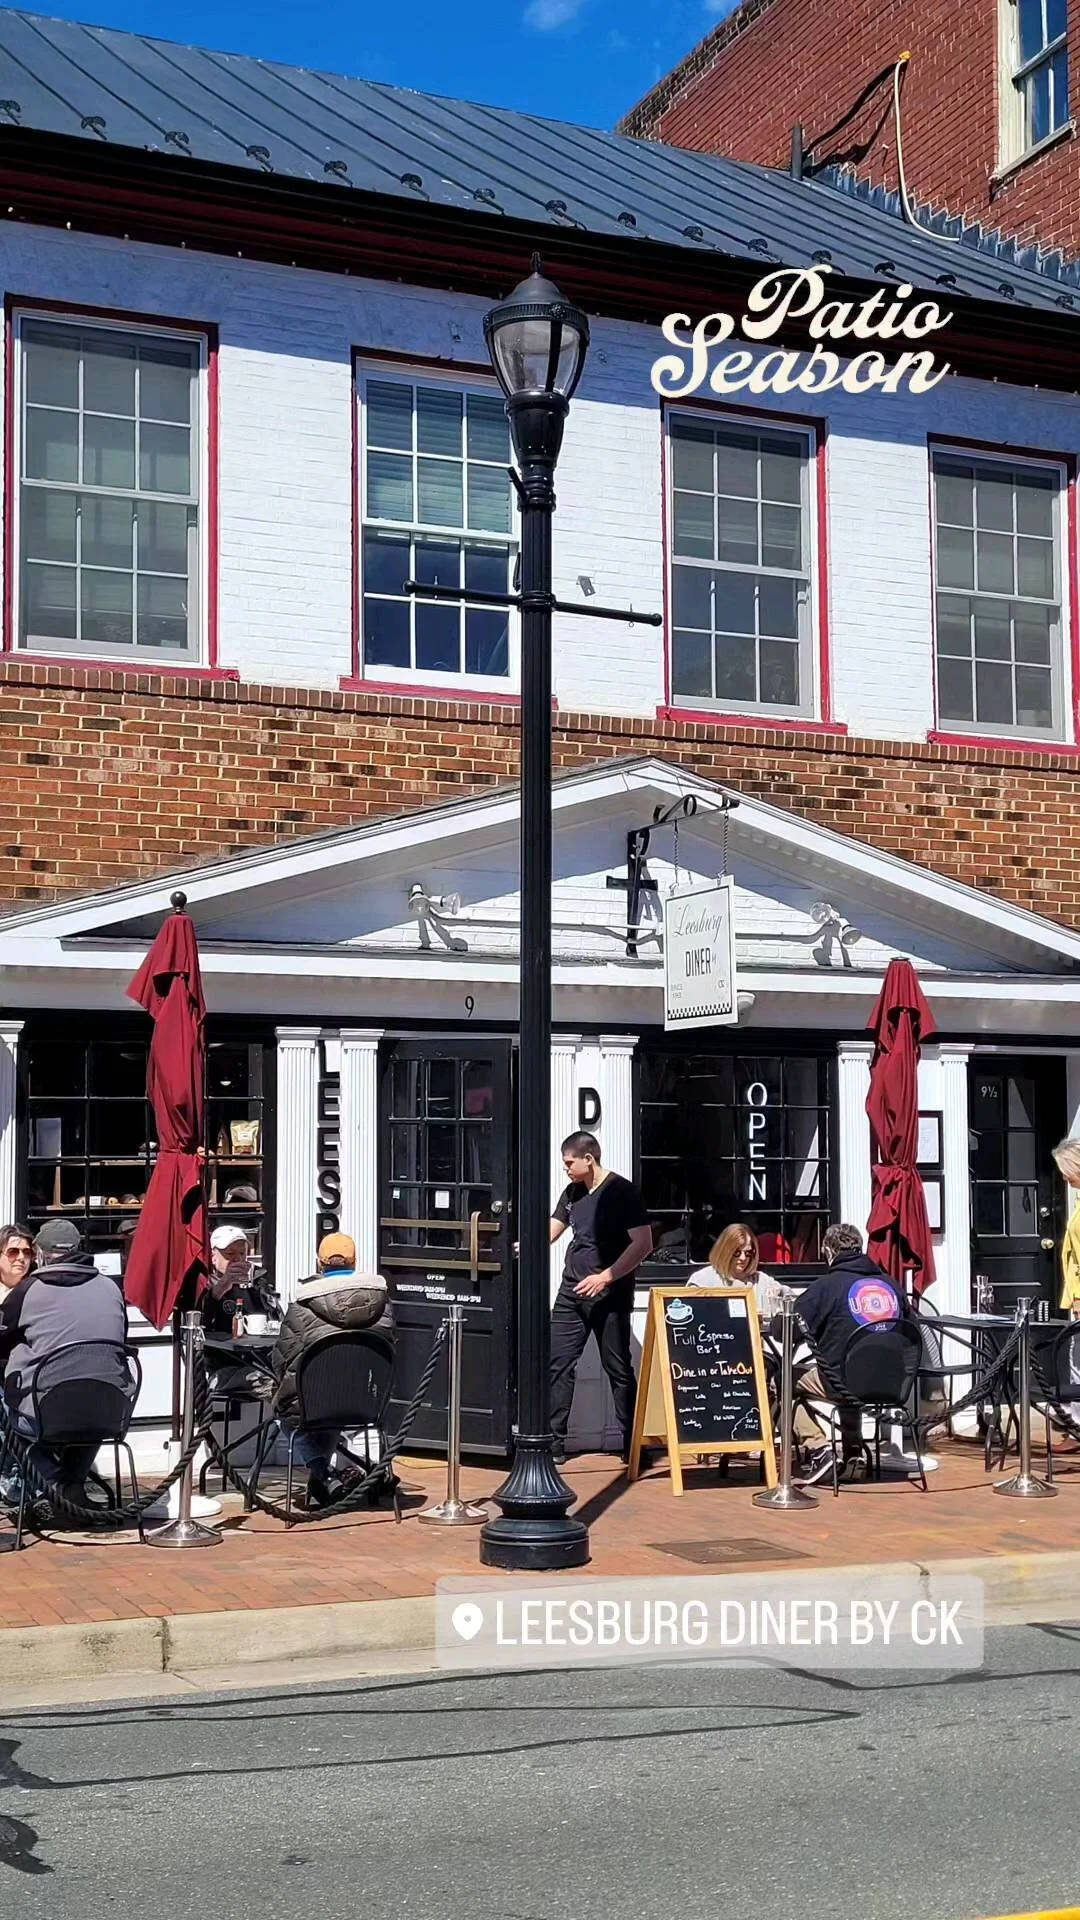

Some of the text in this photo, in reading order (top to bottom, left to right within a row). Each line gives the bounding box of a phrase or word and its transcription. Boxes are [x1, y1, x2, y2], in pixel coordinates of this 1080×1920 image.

[672, 904, 722, 943] Leesburg
[685, 947, 711, 977] DINER
[465, 995, 475, 1018] 9
[747, 1082, 768, 1201] OPEN
[673, 1327, 696, 1345] Full
[671, 1362, 697, 1380] Dine
[698, 1367, 707, 1377] in
